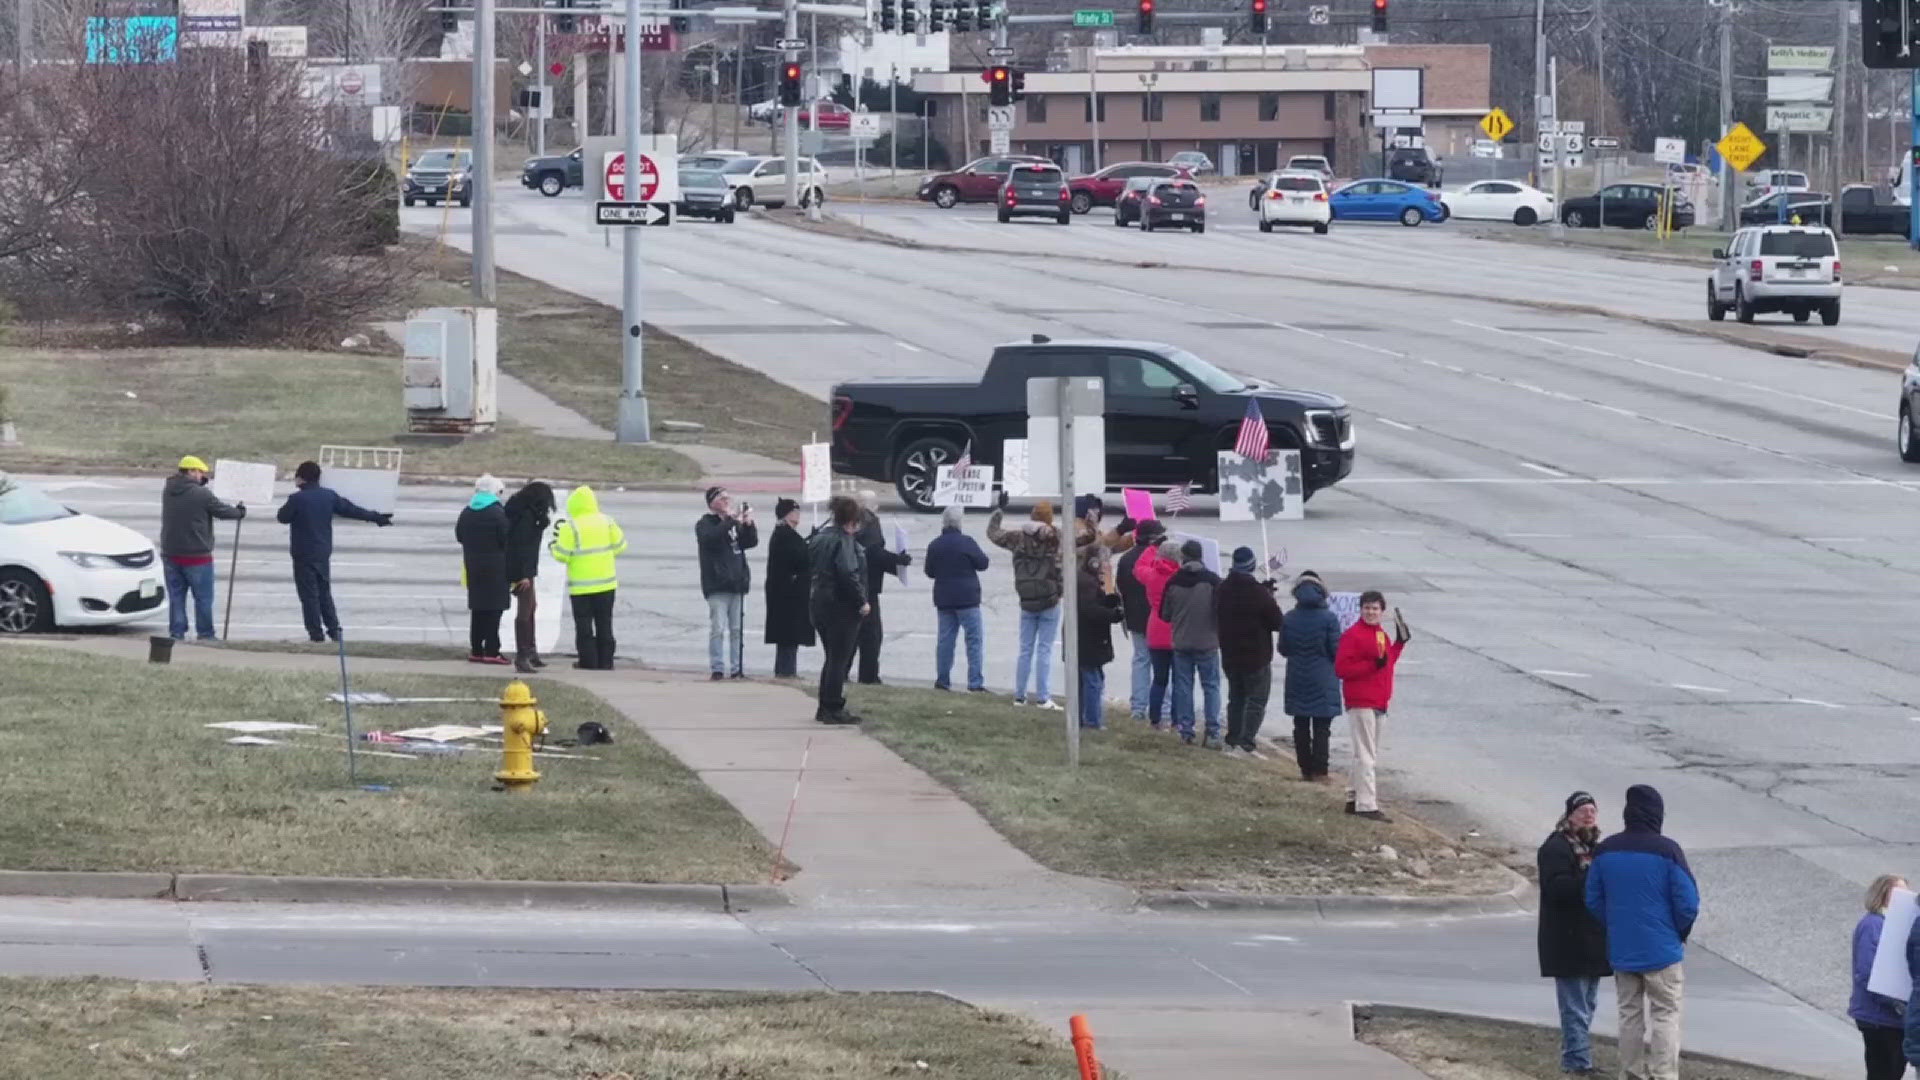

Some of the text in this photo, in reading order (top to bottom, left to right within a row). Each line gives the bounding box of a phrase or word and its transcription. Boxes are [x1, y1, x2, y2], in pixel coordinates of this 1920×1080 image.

[1077, 13, 1110, 25] Brady St
[1774, 110, 1811, 121] Aquatic
[1543, 138, 1550, 149] 6
[1569, 138, 1578, 149] 6
[1729, 154, 1749, 162] ENDS
[612, 162, 626, 172] DO
[603, 208, 648, 218] ONE WAY
